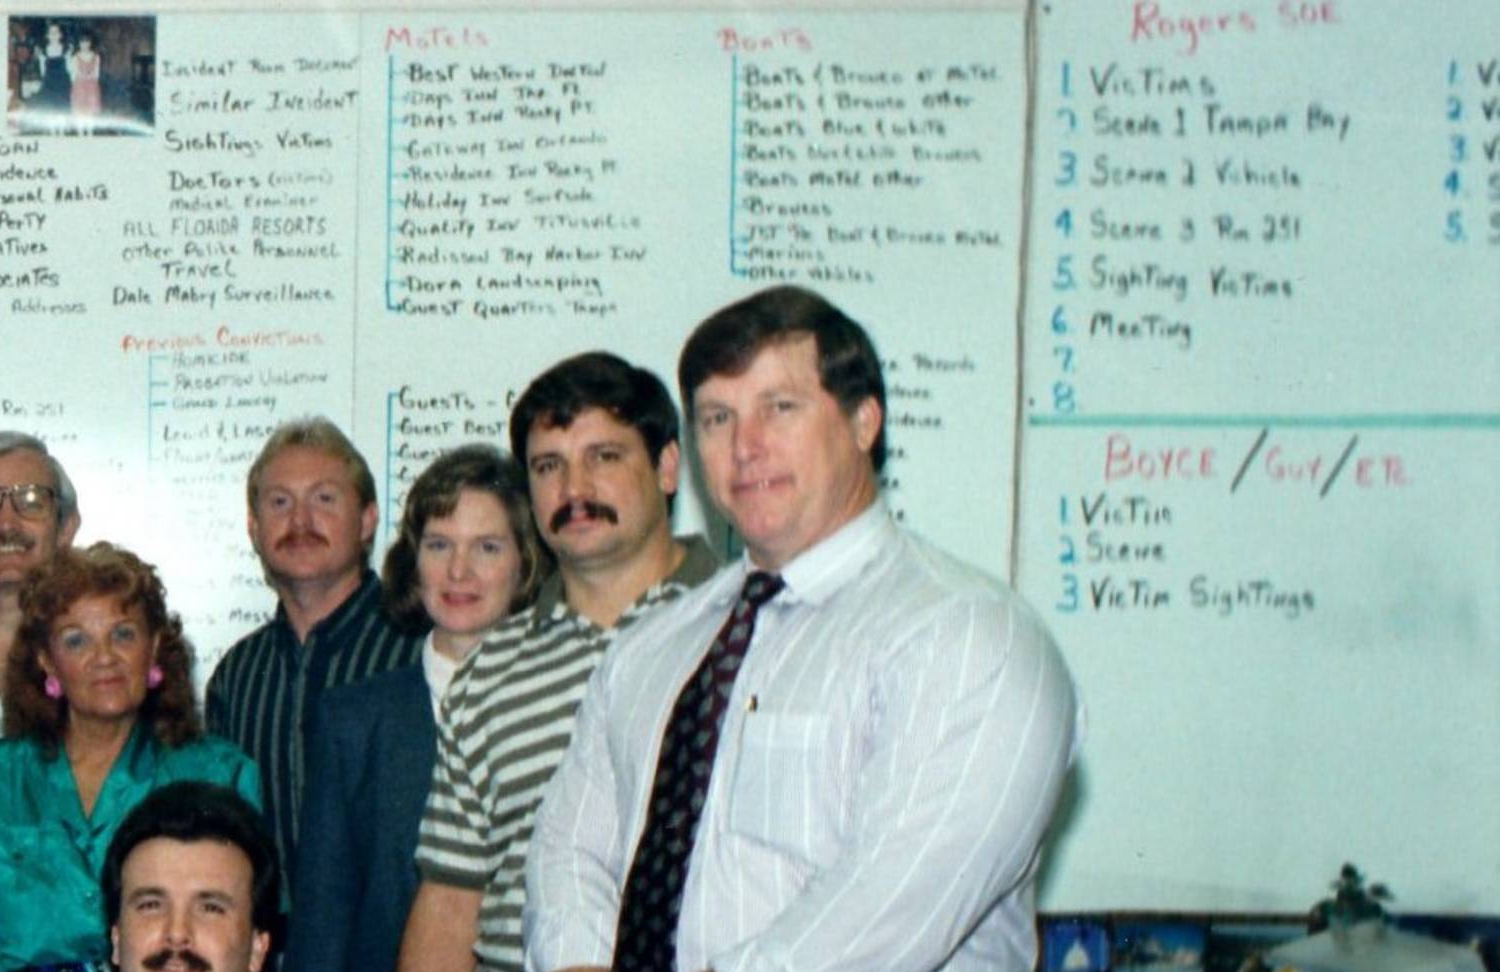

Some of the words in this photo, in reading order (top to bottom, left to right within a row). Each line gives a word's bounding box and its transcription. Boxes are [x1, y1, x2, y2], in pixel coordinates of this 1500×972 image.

[170, 90, 255, 115] Similar
[1202, 102, 1290, 138] Tampa
[252, 216, 327, 236] RESORTS
[112, 287, 151, 306] Dale
[165, 286, 216, 309] Mabry
[224, 284, 334, 302] Surveillance
